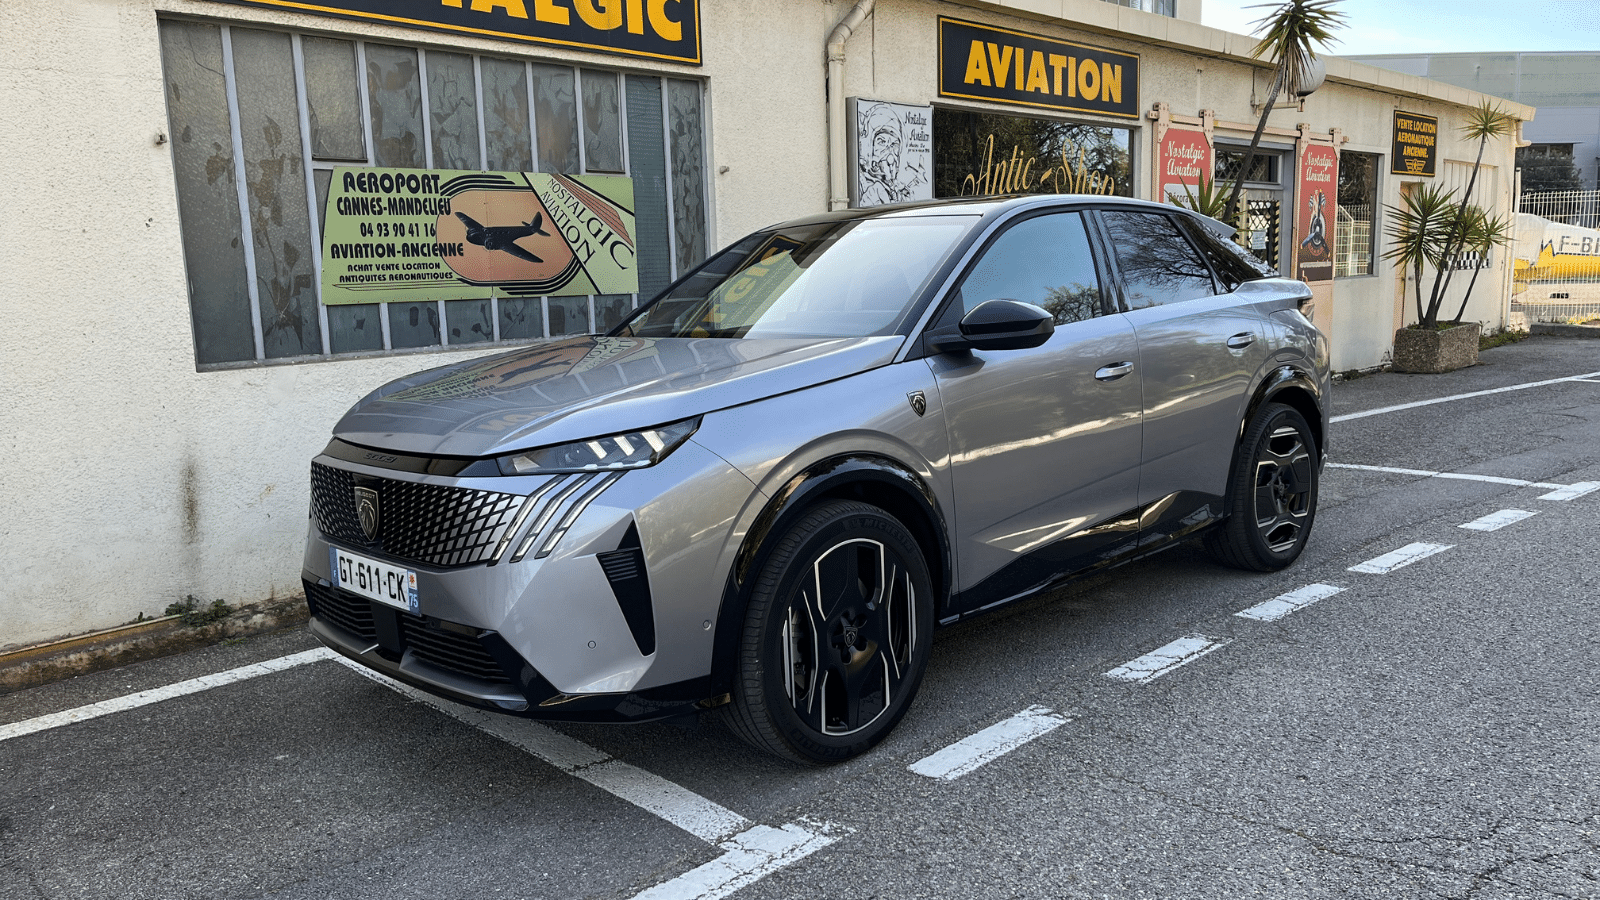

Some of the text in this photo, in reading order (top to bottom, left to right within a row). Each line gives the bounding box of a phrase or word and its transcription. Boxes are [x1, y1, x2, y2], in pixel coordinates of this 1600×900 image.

[964, 39, 1122, 104] AVIATION
[1396, 118, 1436, 134] VENTE LOCATION
[1397, 131, 1435, 147] AERONAUTIQUE
[1165, 141, 1205, 164] Nostalgic
[1305, 152, 1333, 171] Nostalgic
[961, 134, 1036, 196] Antic
[1167, 158, 1200, 178] Aviation
[1306, 166, 1331, 182] Aviation
[343, 171, 440, 194] AEROPORT
[336, 196, 452, 216] CANNES-MANDELIEU
[360, 222, 436, 238] 04 93 90 41 16
[540, 191, 596, 265] AVIATION
[547, 178, 634, 270] NOSTALGIC
[330, 242, 464, 259] AVIATION-ANCIENNE
[347, 262, 441, 272] ACHAT VENTE LOCATION
[339, 272, 453, 283] ANTIQUITES AERONAUTIQUES
[363, 452, 398, 463] 3008
[339, 556, 406, 603] GT-611-CK
[409, 592, 419, 608] 75
